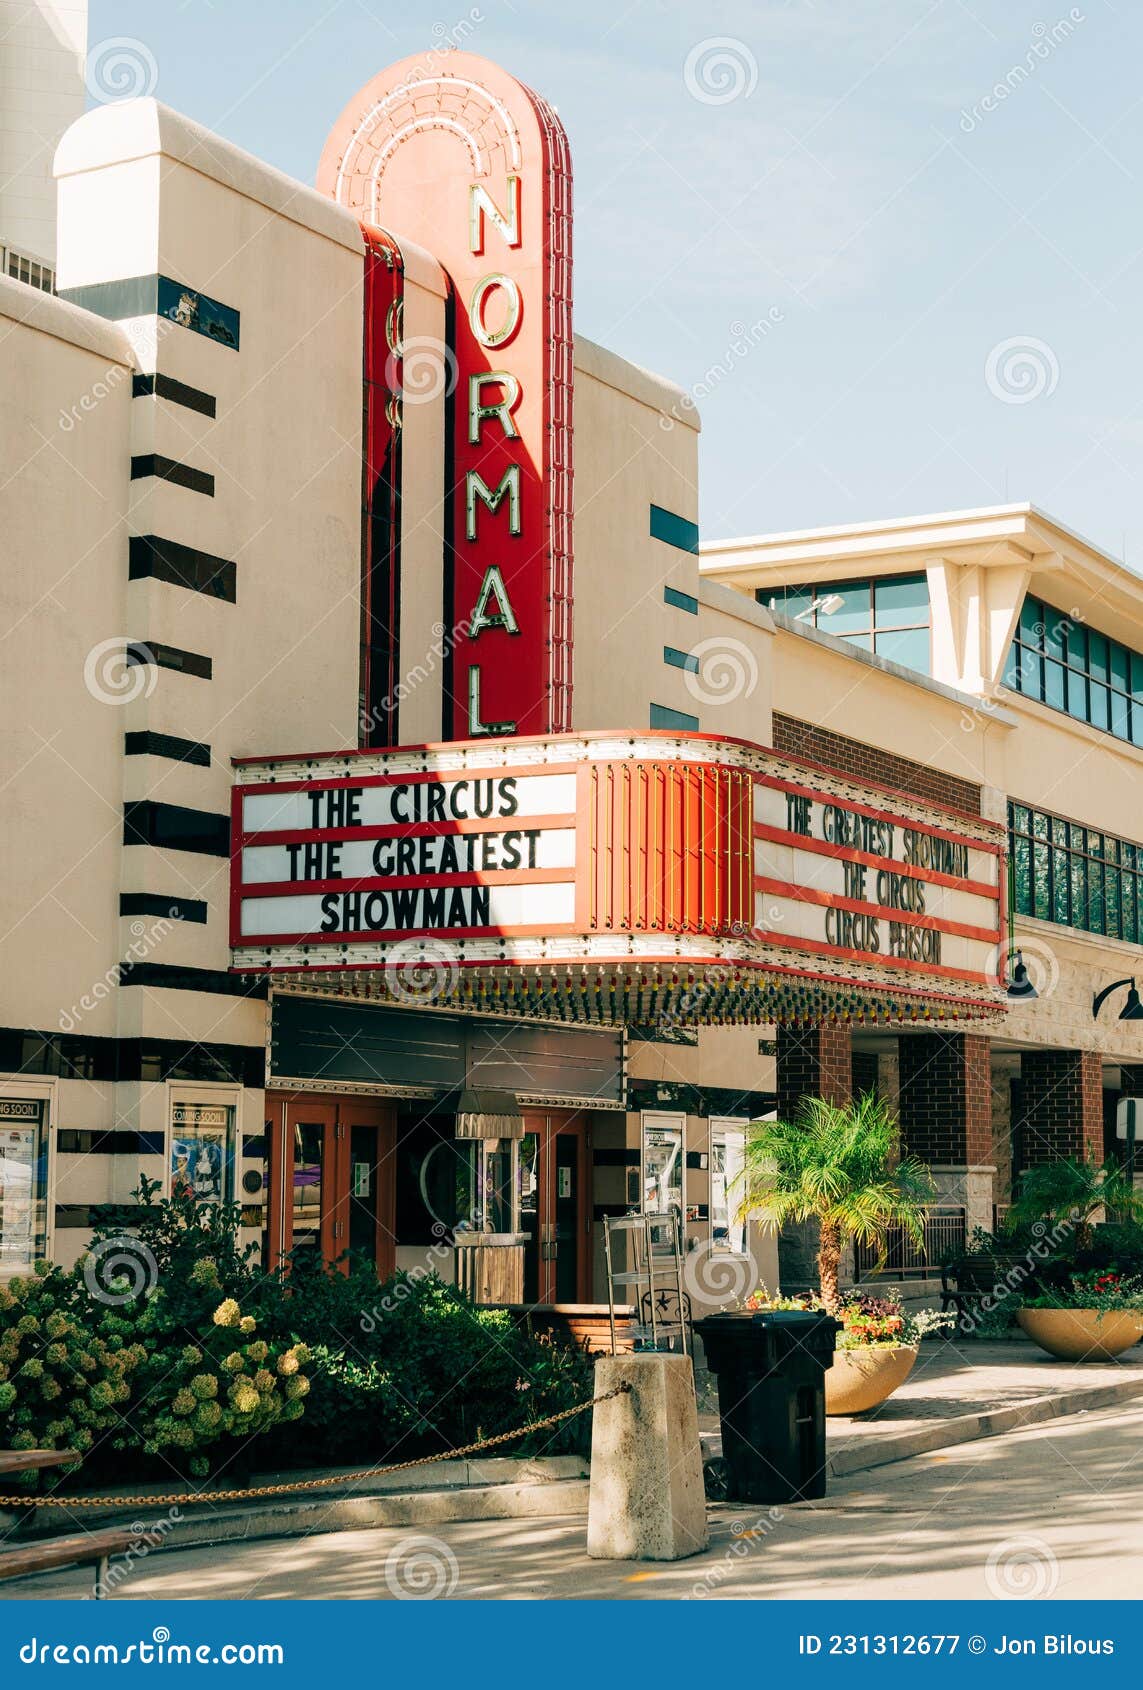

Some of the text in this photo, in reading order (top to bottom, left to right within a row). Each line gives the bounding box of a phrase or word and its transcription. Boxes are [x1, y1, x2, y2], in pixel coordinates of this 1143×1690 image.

[467, 174, 523, 737] NORMAL
[308, 777, 518, 828] THE CIRCUS
[286, 830, 542, 882] THE GREATEST
[785, 792, 969, 880] THE GREATEST SHOWMAN
[319, 886, 491, 933] SHOWMAN
[842, 860, 927, 914] THE CIRCUS
[825, 907, 942, 967] CIRCUS PERSON
[11, 1104, 34, 1116] SOON
